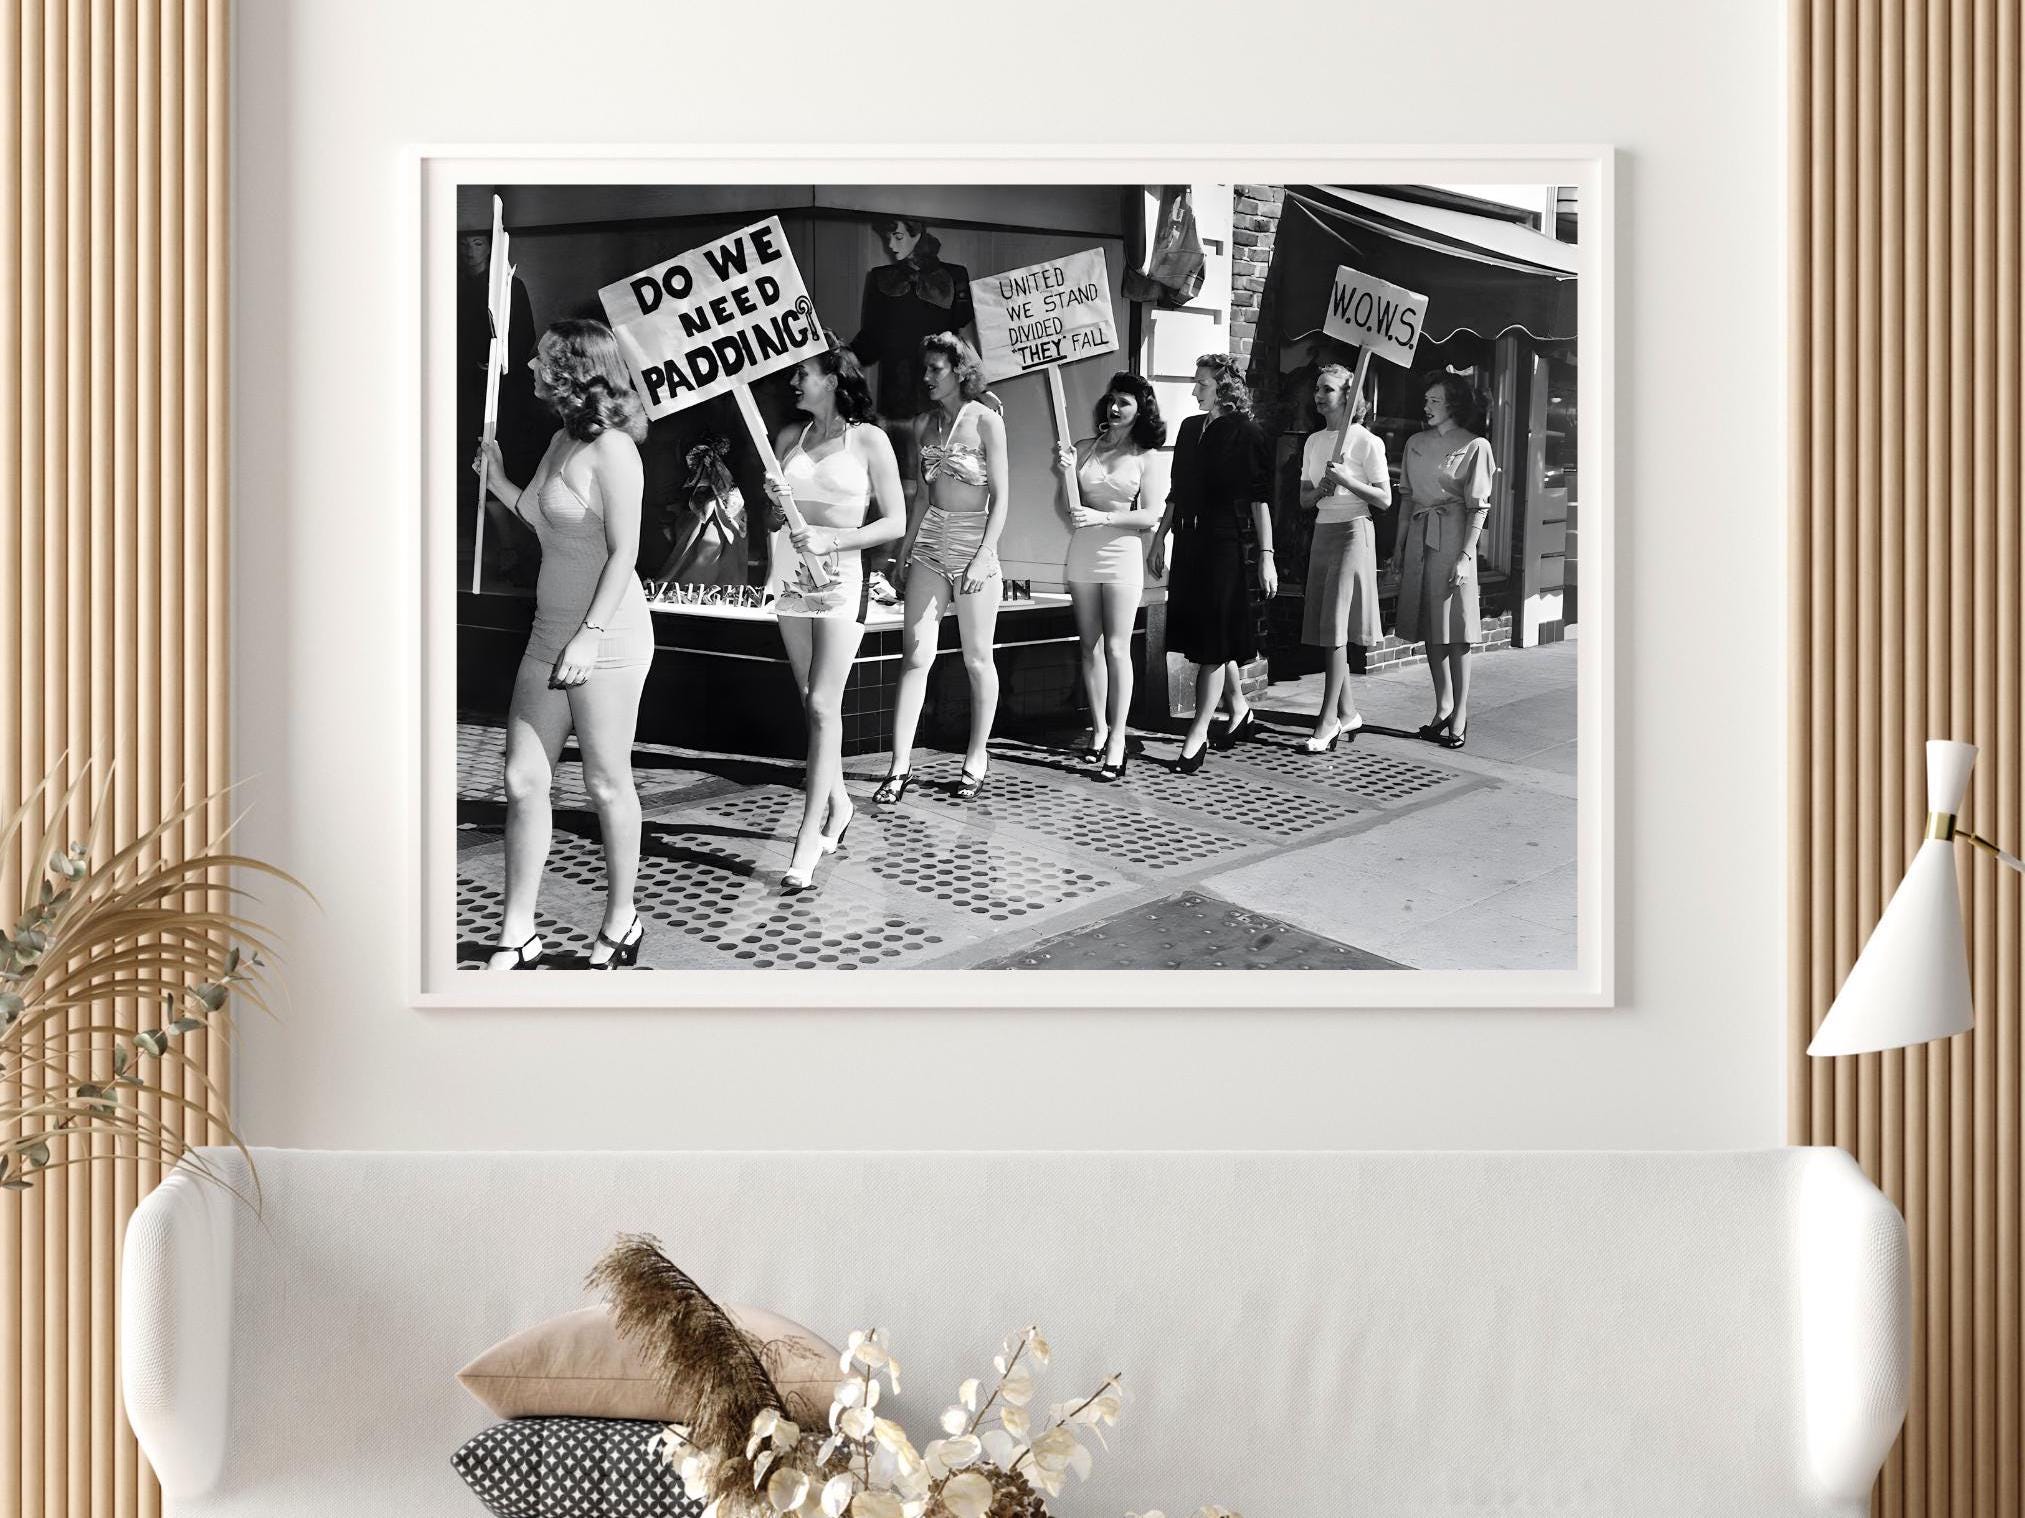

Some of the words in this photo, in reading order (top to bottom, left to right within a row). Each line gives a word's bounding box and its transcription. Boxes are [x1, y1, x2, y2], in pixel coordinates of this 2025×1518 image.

[630, 265, 693, 315] DO
[703, 225, 782, 282] WE
[999, 267, 1065, 300] UNITED
[678, 276, 780, 337] NEED
[1006, 302, 1034, 321] WE
[1043, 283, 1098, 313] STAND
[1333, 281, 1416, 350] W.O.W.S.
[641, 295, 820, 406] PADDING?
[1008, 317, 1063, 346] DIVIDED
[1071, 328, 1109, 351] FALL
